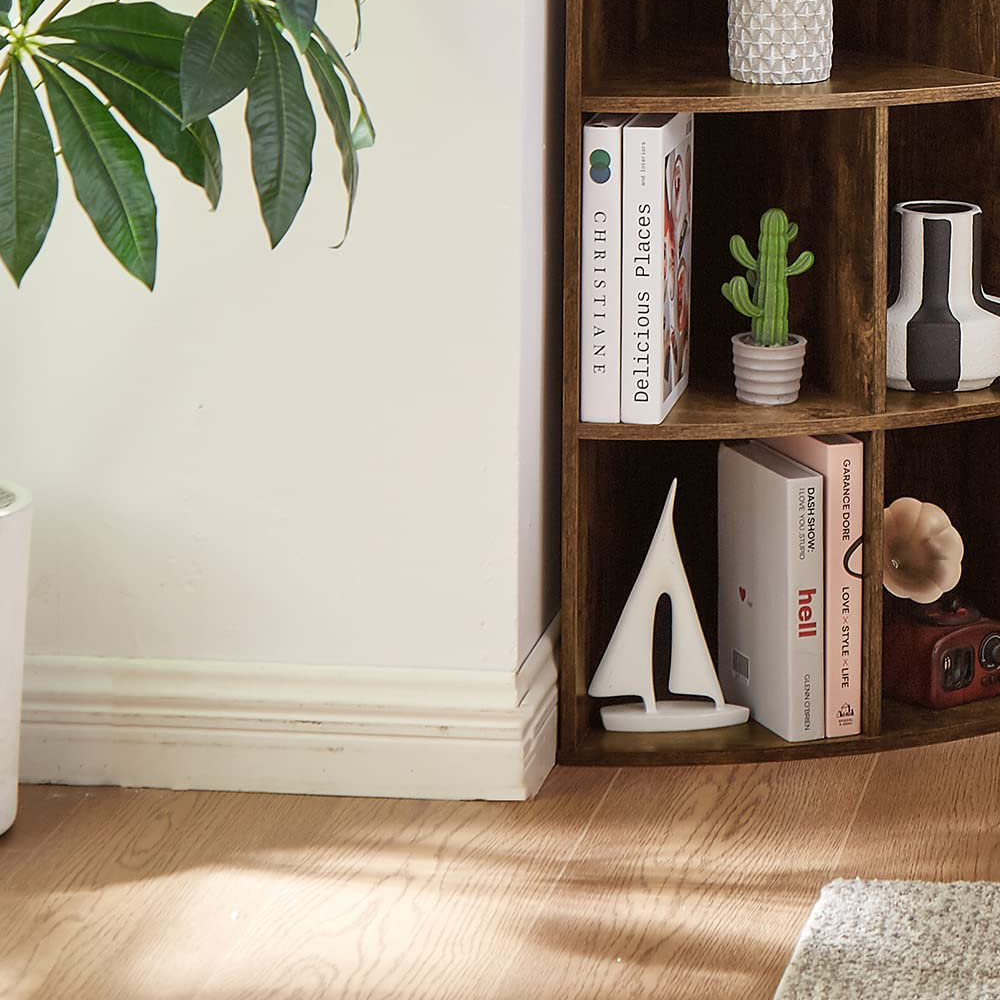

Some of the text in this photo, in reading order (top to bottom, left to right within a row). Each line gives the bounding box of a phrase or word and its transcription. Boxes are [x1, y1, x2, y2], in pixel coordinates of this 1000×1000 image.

[593, 211, 607, 374] CHRISTIANE
[633, 204, 651, 402] Delicious Places
[807, 487, 816, 553] DASH SHOW:
[842, 459, 851, 541] GARANCE DORE
[798, 588, 817, 638] hell
[841, 586, 850, 614] LOVE
[841, 625, 850, 656] STYLE
[841, 667, 850, 688] LIFE
